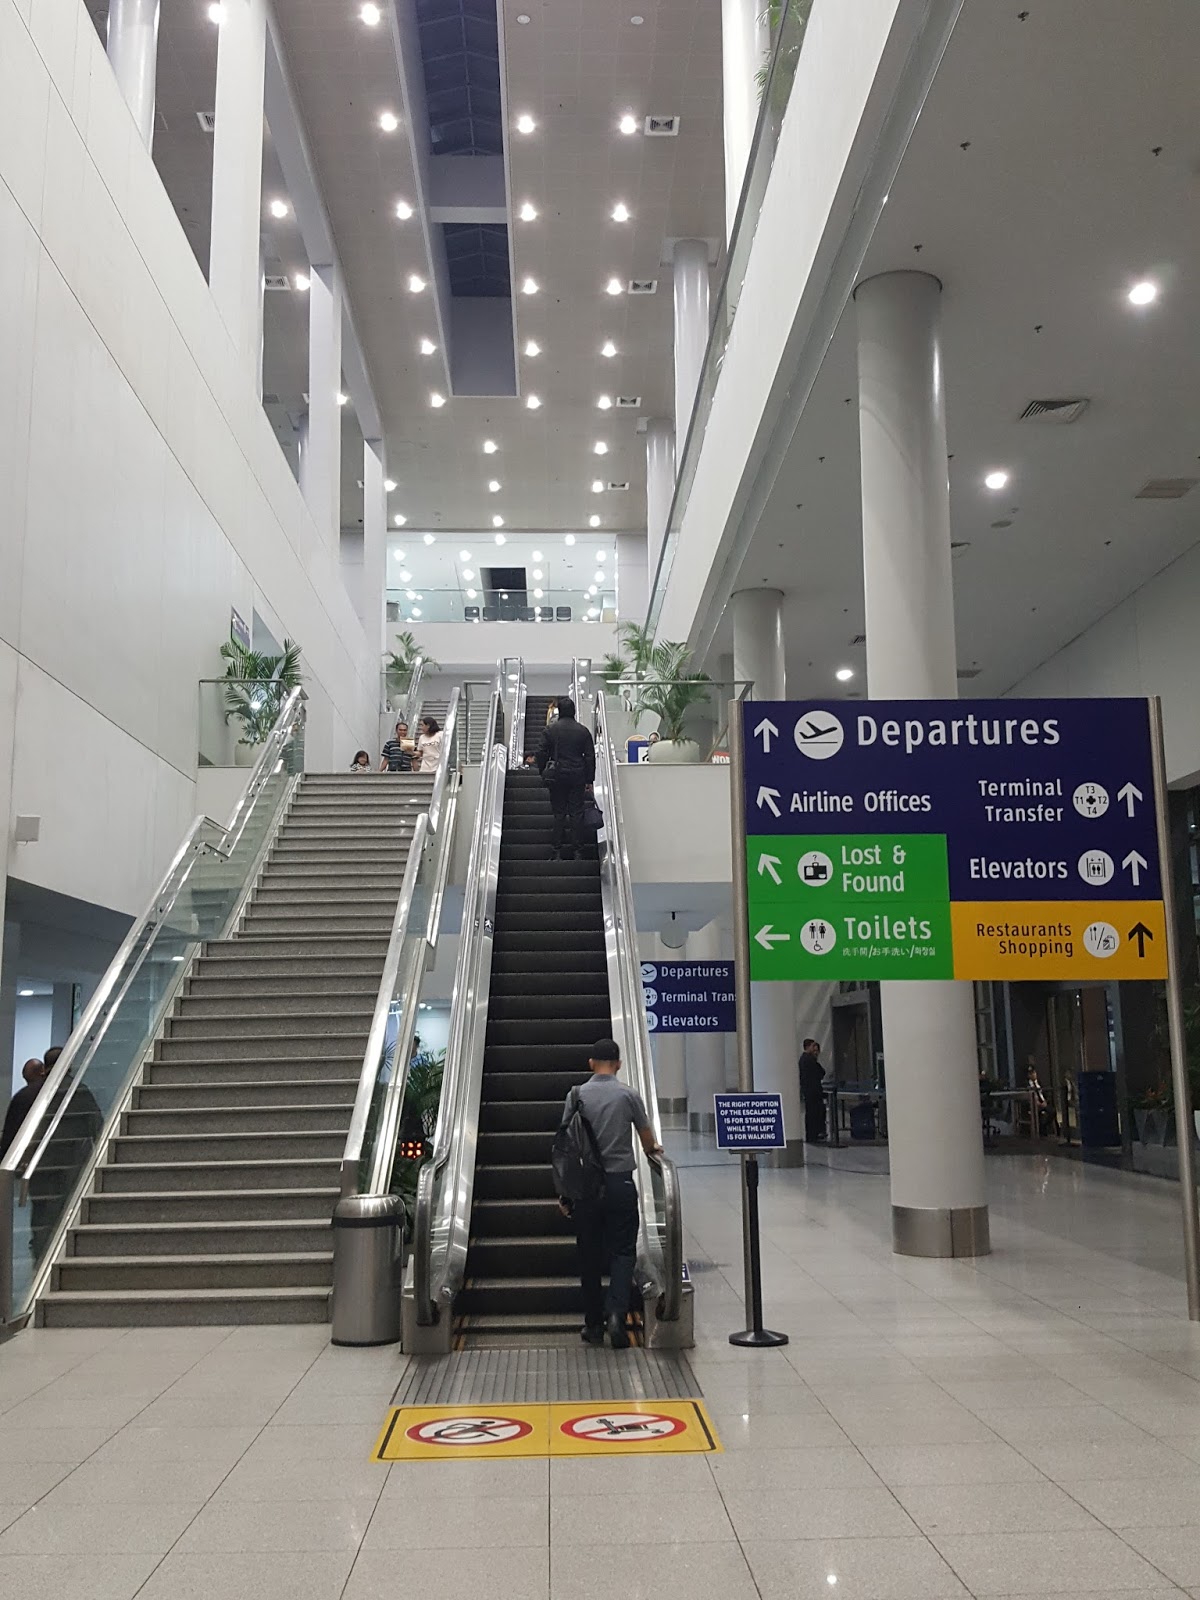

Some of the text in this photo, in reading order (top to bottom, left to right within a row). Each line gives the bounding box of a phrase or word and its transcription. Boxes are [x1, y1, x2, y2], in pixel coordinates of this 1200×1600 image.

[857, 714, 1060, 753] Departures
[978, 778, 1063, 797] Terminal
[1085, 785, 1096, 794] T3
[790, 790, 932, 812] Airline Offices
[1075, 796, 1084, 805] T1
[1098, 796, 1107, 805] T2
[985, 804, 1064, 822] Transfer
[1087, 806, 1098, 815] T4
[841, 845, 906, 865] Lost &
[970, 857, 1068, 879] Elevators
[843, 871, 905, 892] Found
[843, 915, 932, 940] Toilets
[976, 923, 1072, 937] Restaurants
[999, 939, 1073, 958] Shopping
[661, 966, 729, 979] Departures
[661, 991, 708, 1002] Terminal
[662, 1015, 719, 1026] Elevators
